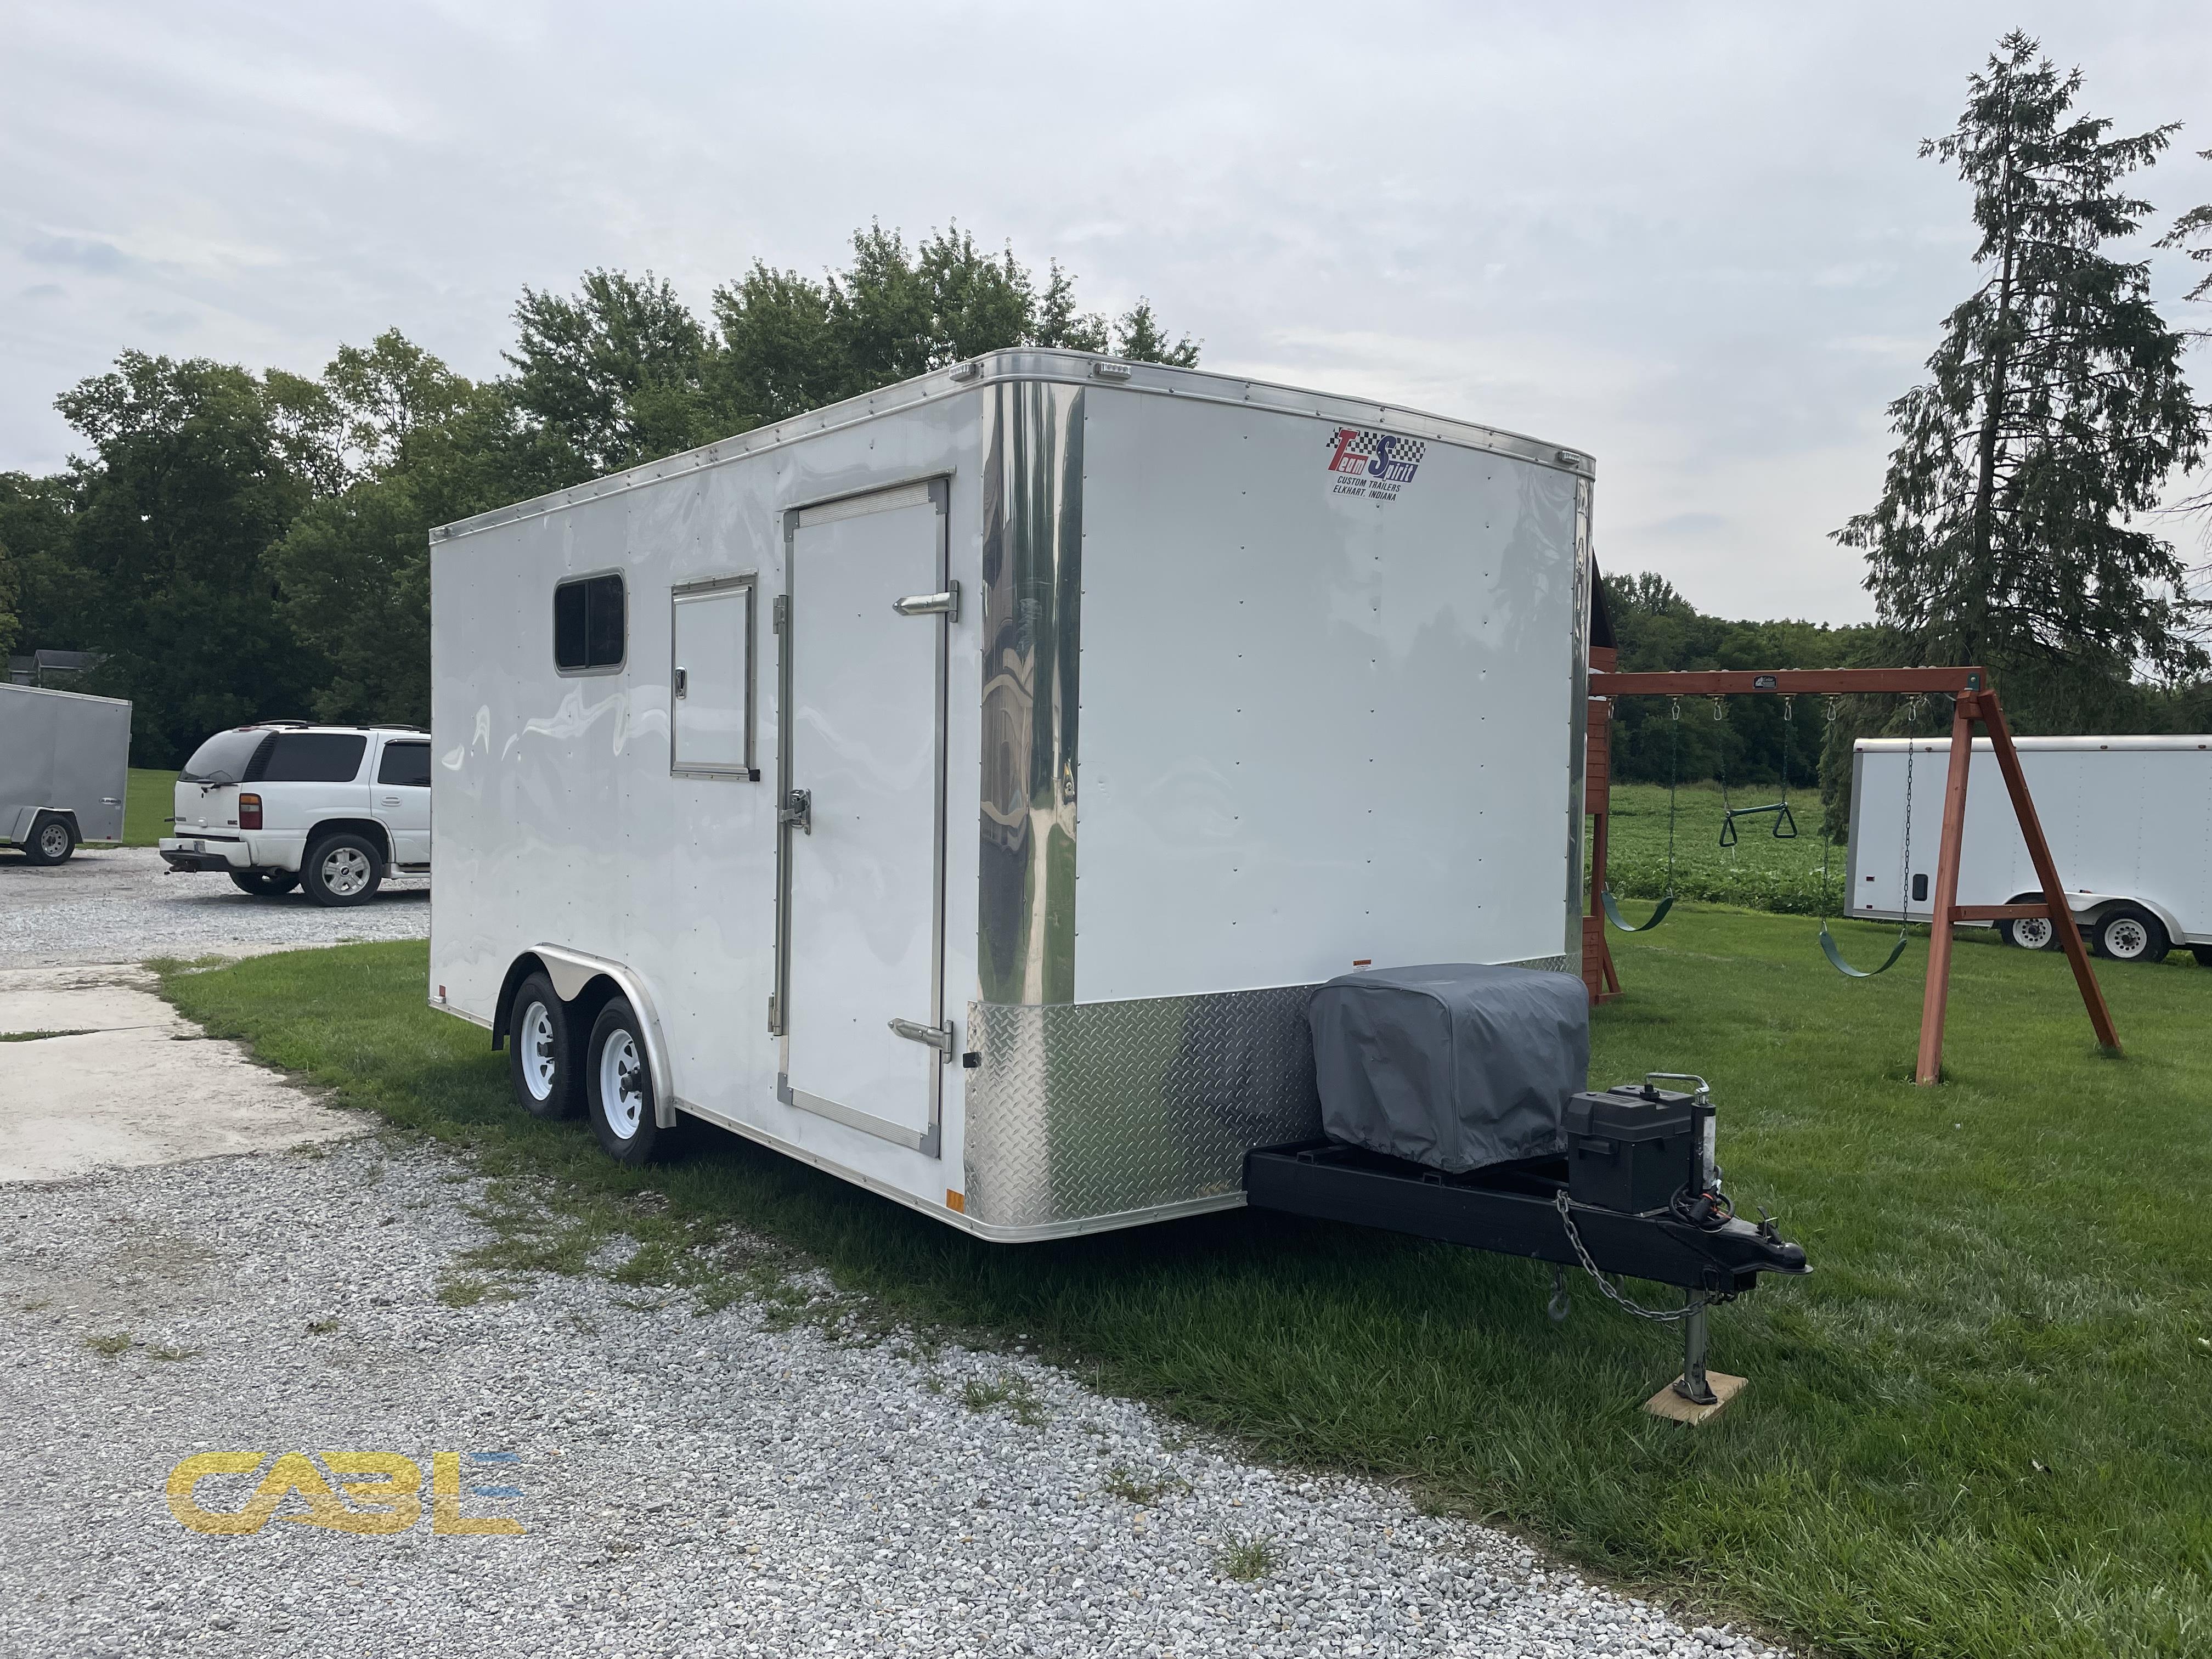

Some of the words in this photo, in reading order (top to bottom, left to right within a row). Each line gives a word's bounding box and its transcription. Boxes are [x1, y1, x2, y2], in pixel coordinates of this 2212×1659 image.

[1328, 428, 1366, 475] Team
[1368, 435, 1414, 481] Spirit
[1337, 476, 1367, 487] CUSTOM
[1369, 481, 1401, 492] TRAILERS
[1368, 490, 1397, 501] INDIANA
